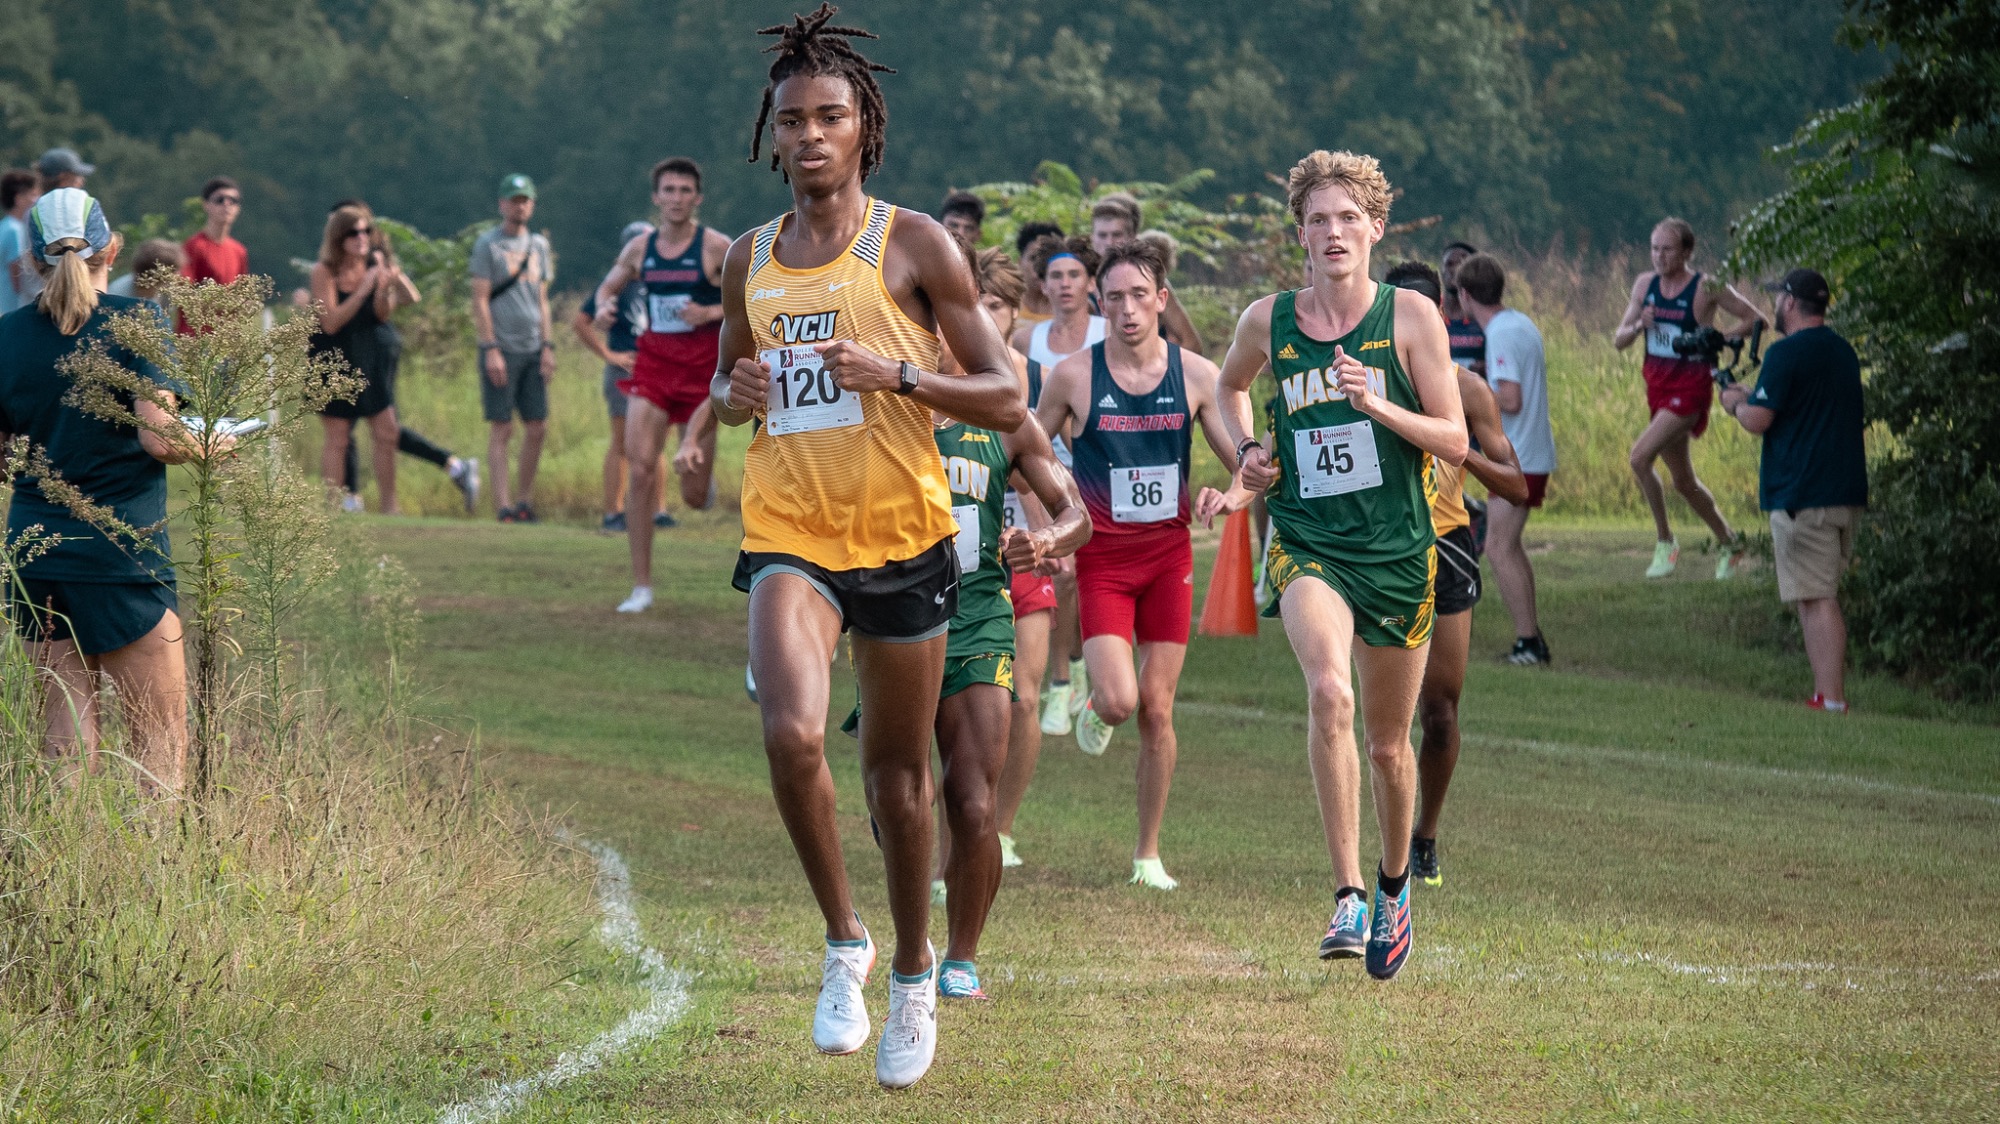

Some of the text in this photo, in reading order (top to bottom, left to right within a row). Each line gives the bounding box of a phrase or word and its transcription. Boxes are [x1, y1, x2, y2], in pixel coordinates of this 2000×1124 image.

[770, 310, 840, 344] VCU
[794, 352, 823, 361] RUNNI
[1358, 339, 1391, 351] A10
[776, 367, 841, 410] 120
[1281, 366, 1387, 416] MASN
[1097, 413, 1185, 432] RICHMOND
[1322, 430, 1353, 440] RUNNING
[1316, 442, 1354, 476] 45
[1132, 481, 1163, 507] 86
